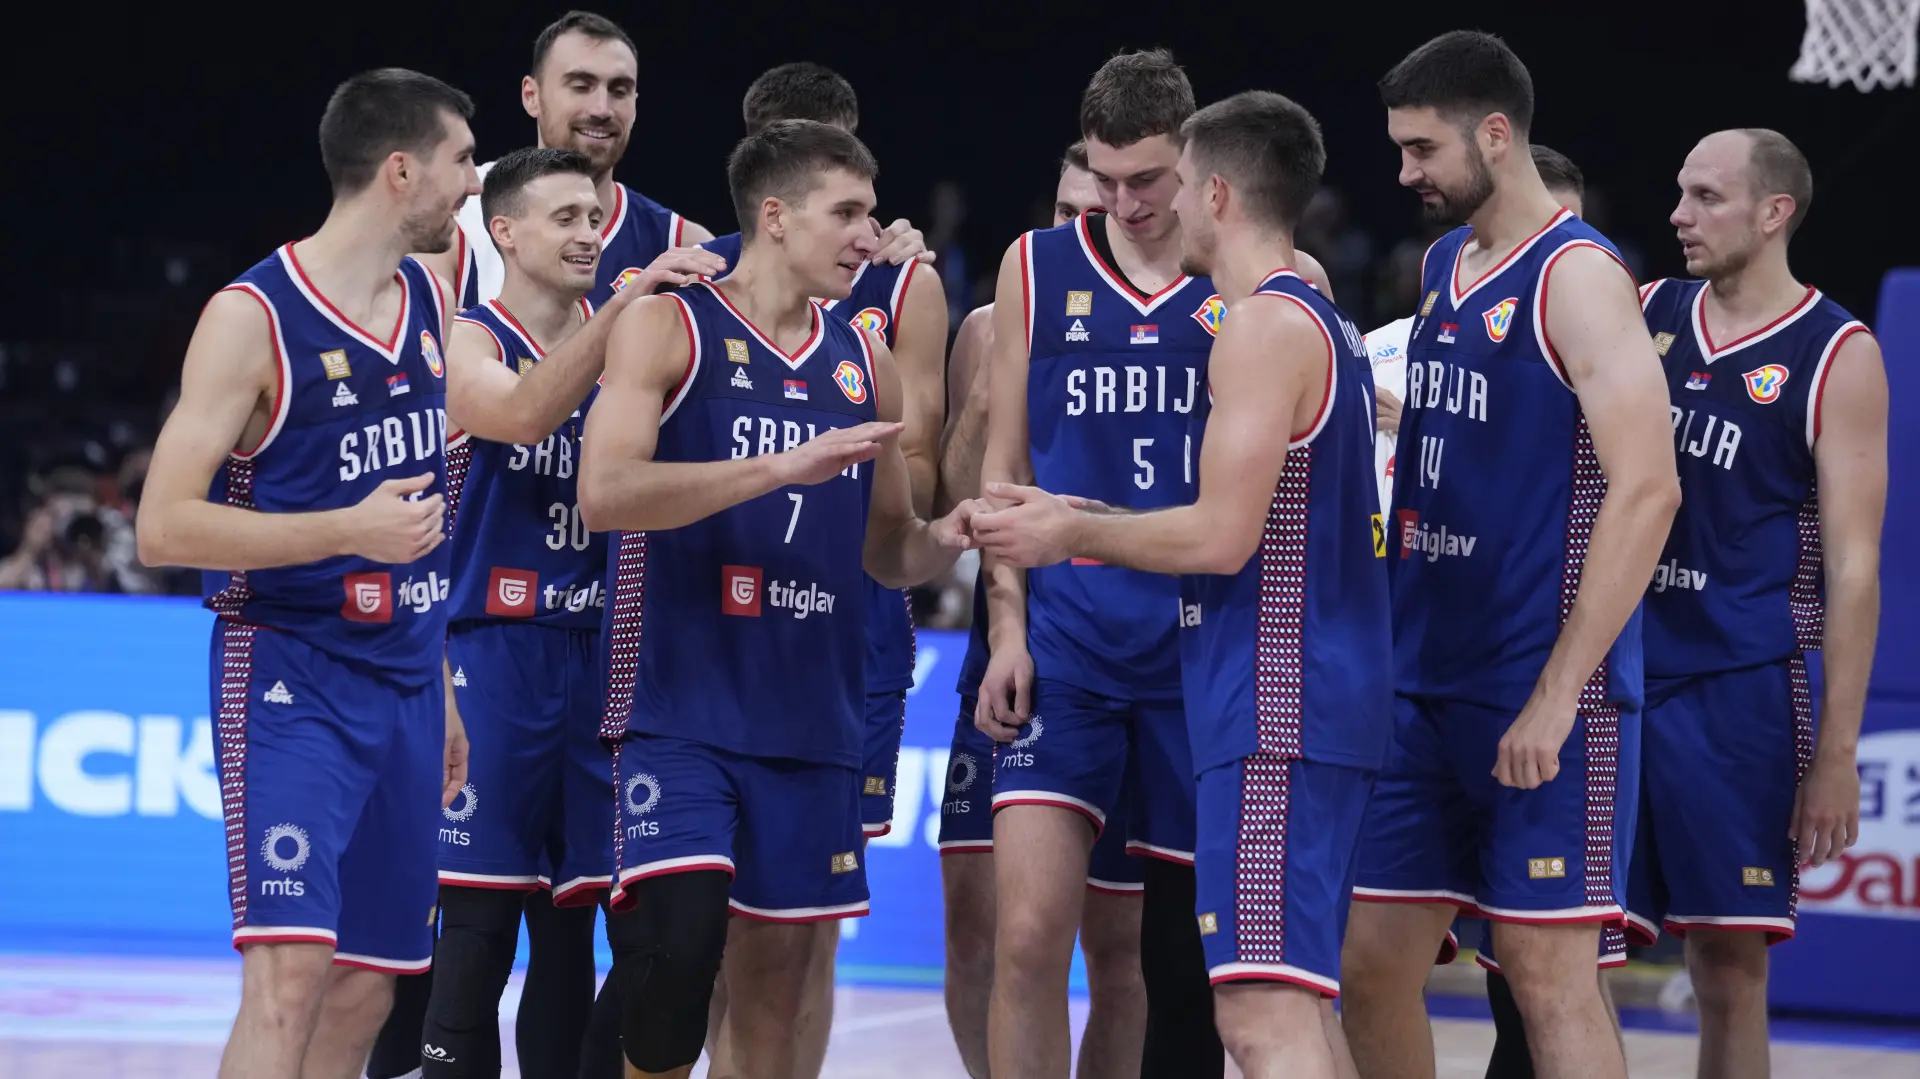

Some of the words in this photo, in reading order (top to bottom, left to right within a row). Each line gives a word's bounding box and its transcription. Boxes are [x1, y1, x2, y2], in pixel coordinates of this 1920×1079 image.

[1065, 331, 1091, 342] PEAK
[730, 376, 754, 391] PEAK
[1408, 360, 1489, 422] RBIJA
[331, 393, 360, 408] PEAK
[1133, 438, 1155, 490] 5
[1419, 435, 1445, 490] 14
[545, 502, 590, 551] 30
[783, 492, 803, 544] 7
[1651, 558, 1708, 593] glav
[768, 579, 836, 619] triglav
[1001, 750, 1035, 769] mts
[943, 798, 971, 815] mts
[438, 826, 471, 846] mts
[627, 819, 660, 841] mts
[261, 876, 305, 897] mts
